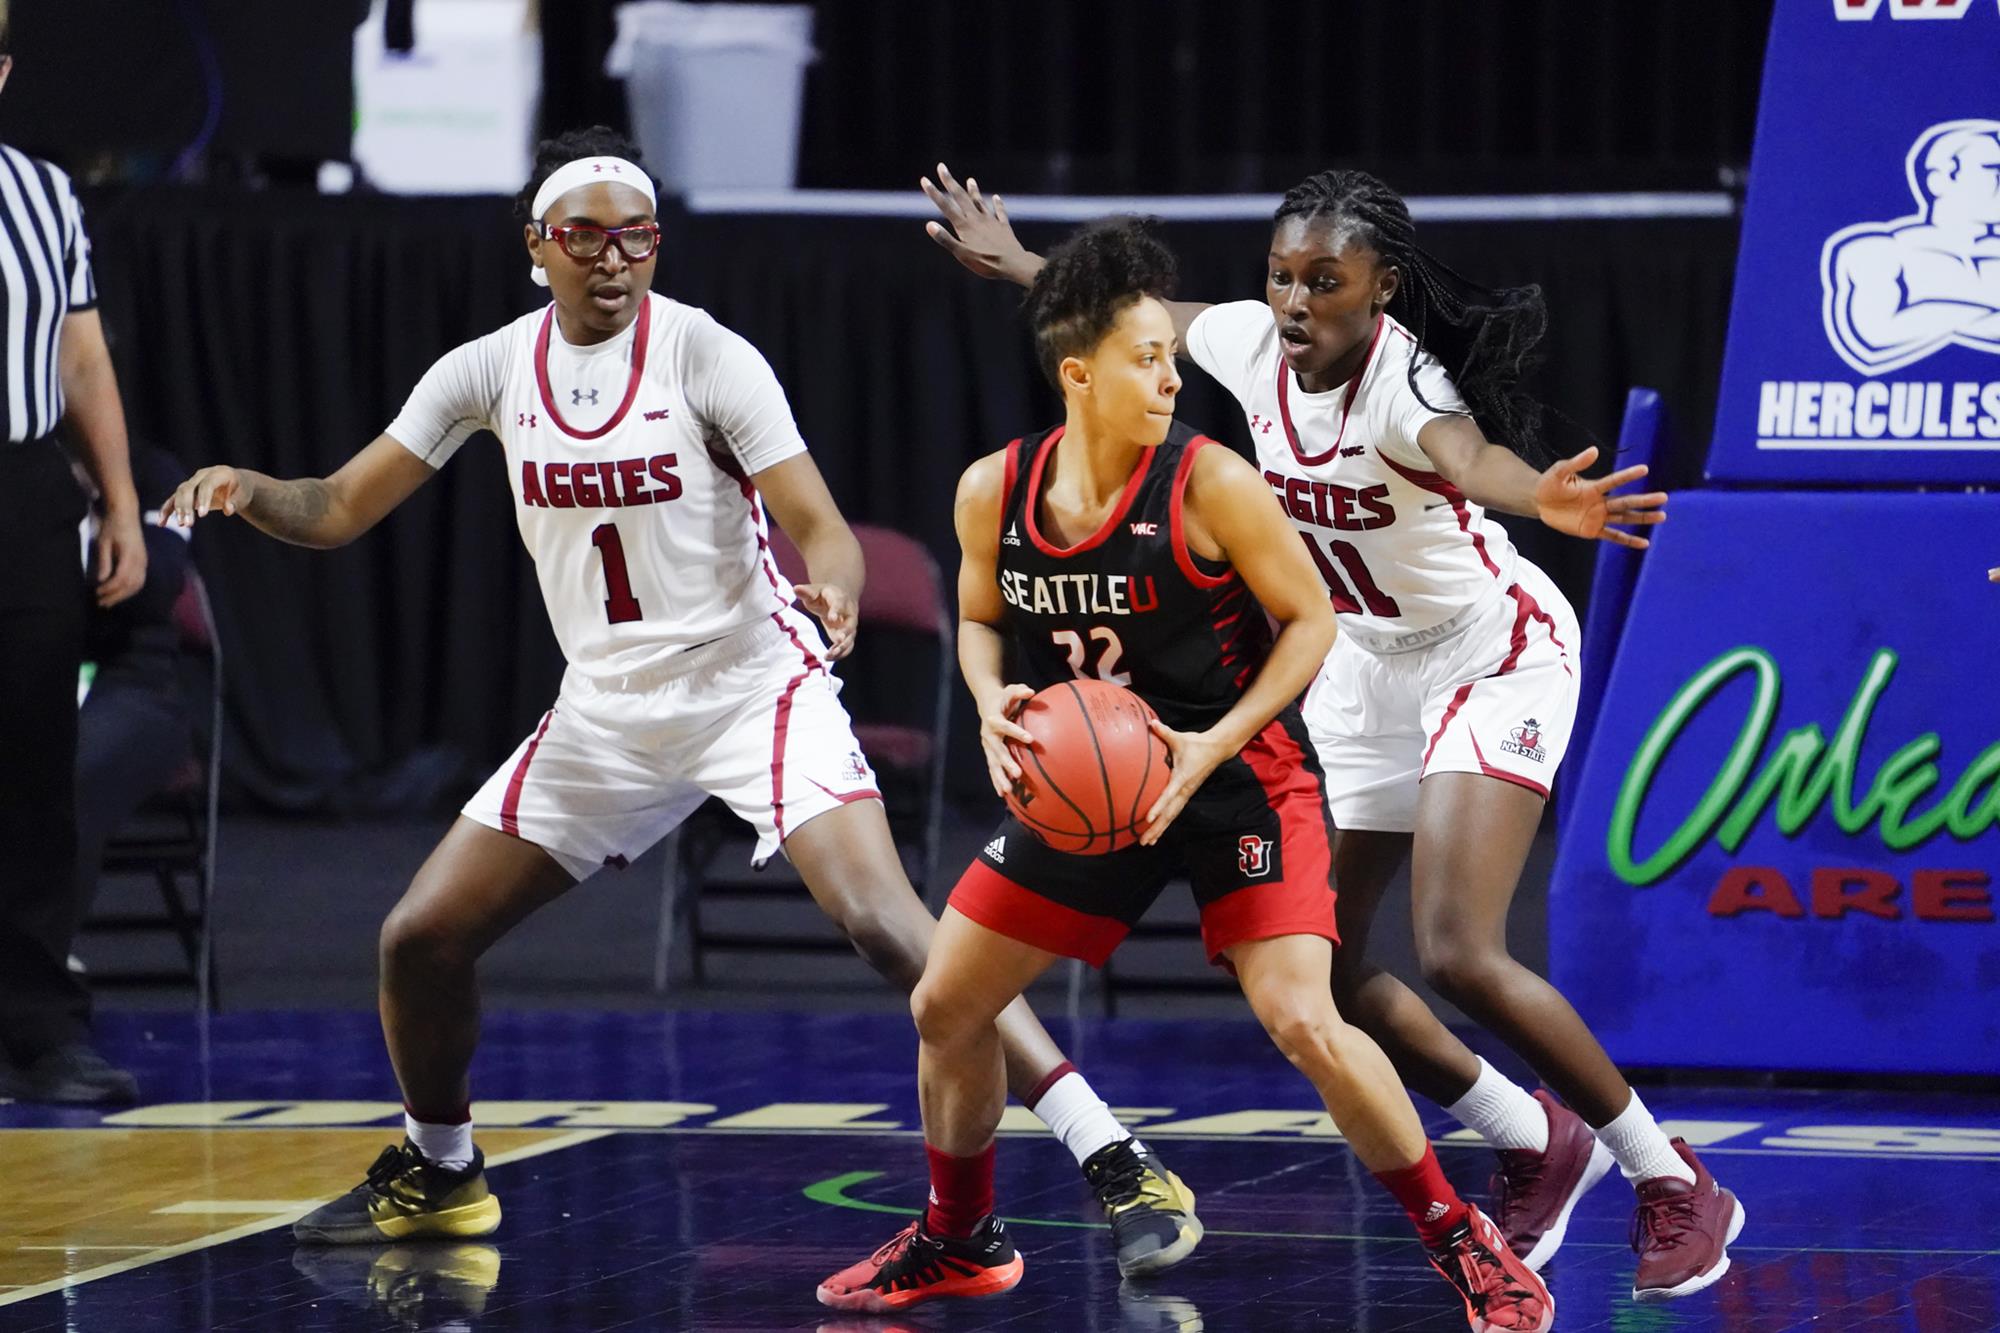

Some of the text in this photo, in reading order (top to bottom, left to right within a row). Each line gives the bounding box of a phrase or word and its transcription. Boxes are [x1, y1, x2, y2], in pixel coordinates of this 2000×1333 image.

[1757, 381, 2000, 438] HERCULES
[522, 453, 683, 508] AGGIES
[1264, 470, 1396, 531] GIES
[592, 522, 643, 624] 1
[1298, 531, 1401, 617] 11
[1706, 866, 1995, 919] ARE
